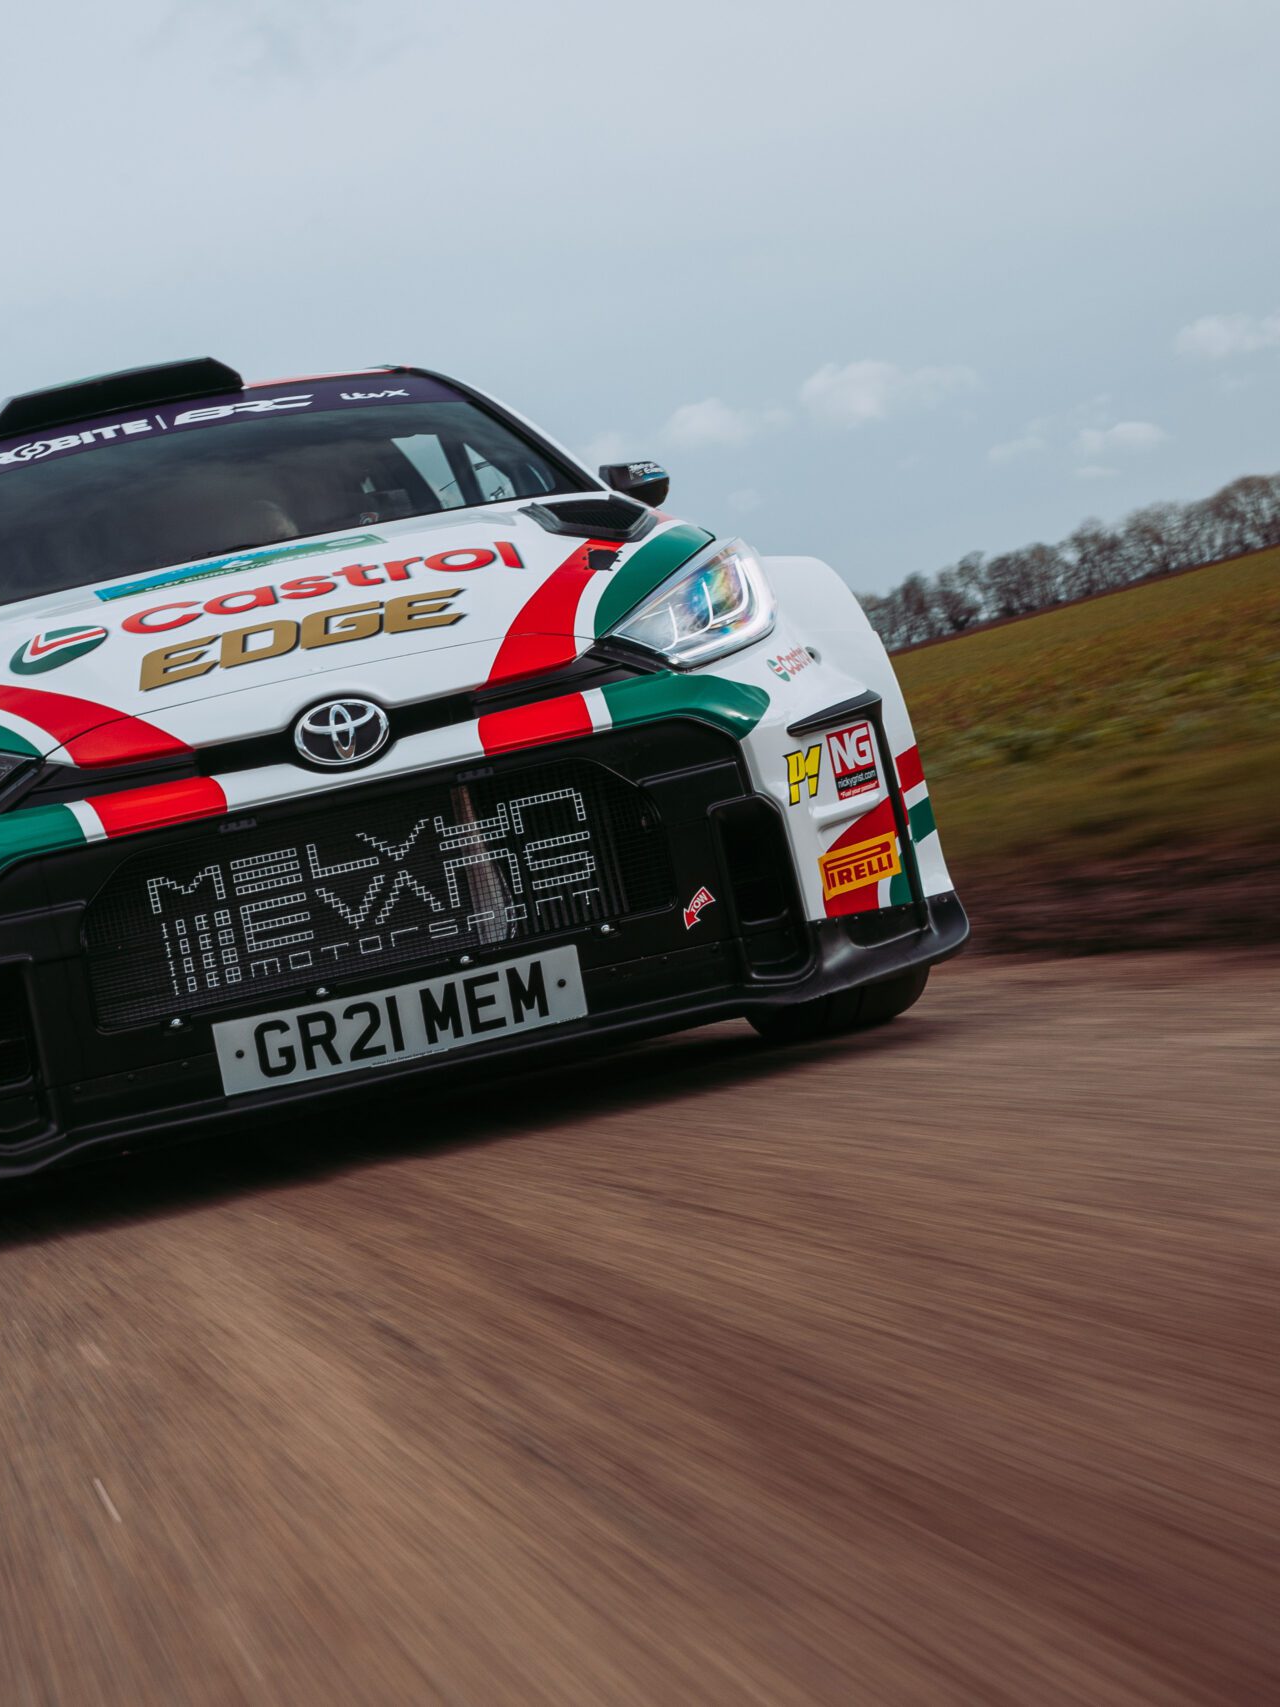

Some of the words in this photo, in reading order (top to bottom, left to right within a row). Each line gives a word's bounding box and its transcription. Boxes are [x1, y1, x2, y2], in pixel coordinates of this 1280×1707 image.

[121, 541, 523, 635] Castrol
[138, 587, 469, 692] EDGE
[782, 743, 822, 806] P1
[828, 726, 874, 774] NG
[239, 830, 596, 953] EVANS
[690, 892, 709, 913] TOW
[823, 840, 894, 891] PIRELLI
[250, 887, 601, 979] MOTORSPORT
[253, 994, 407, 1079] GR21
[419, 961, 552, 1046] MEM
